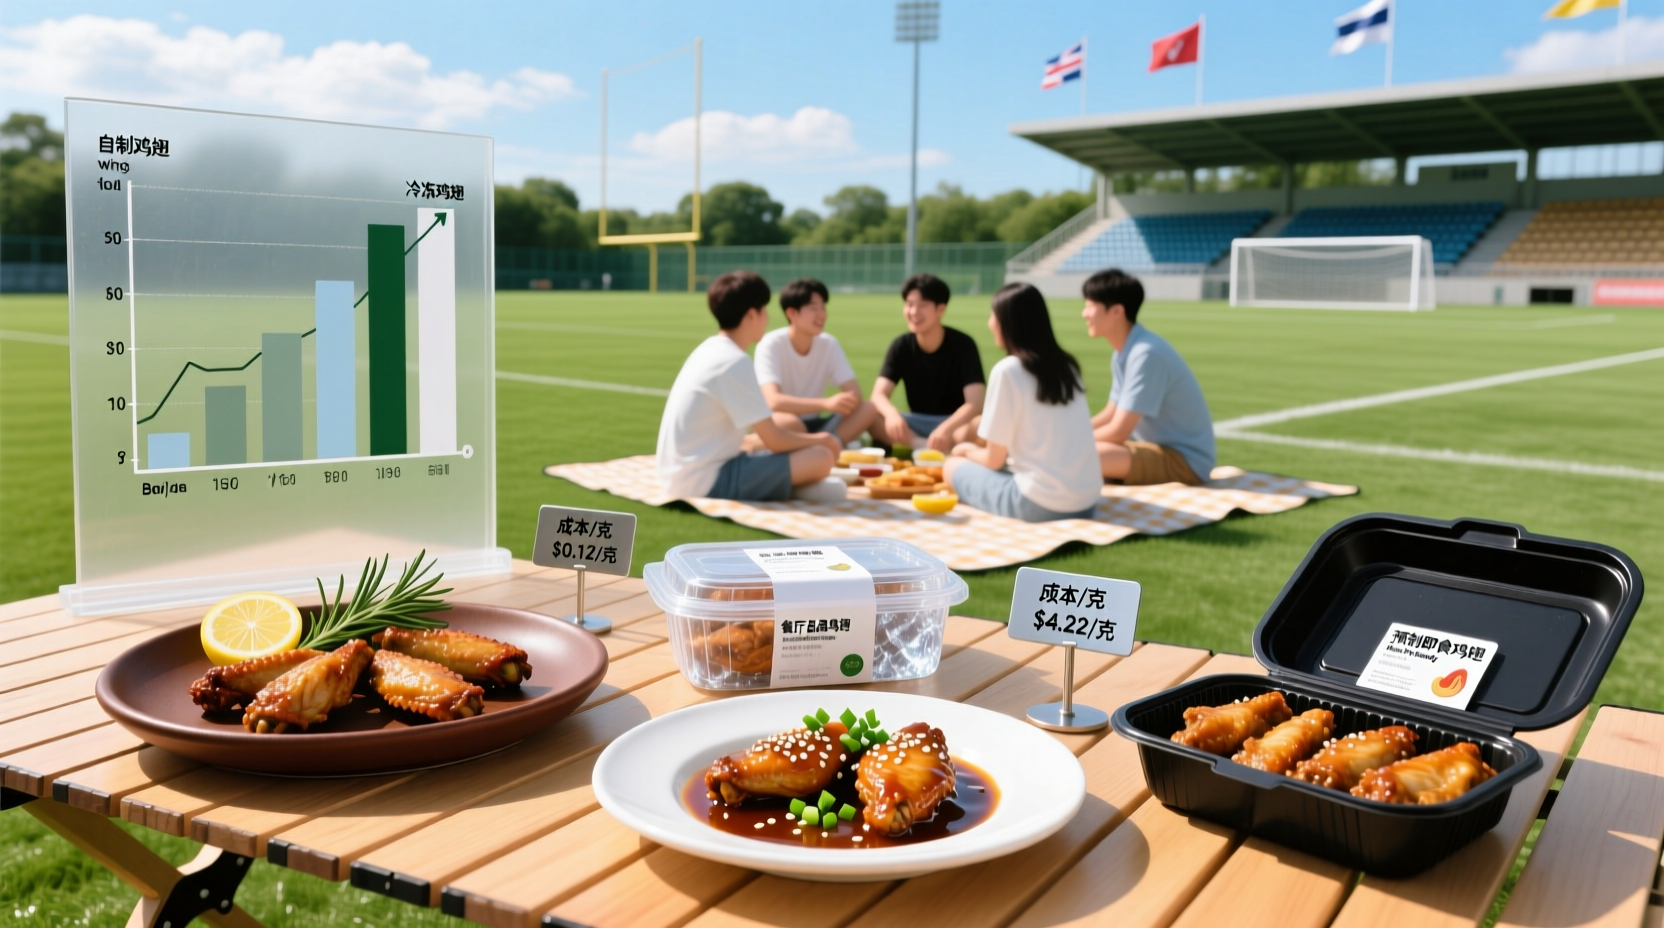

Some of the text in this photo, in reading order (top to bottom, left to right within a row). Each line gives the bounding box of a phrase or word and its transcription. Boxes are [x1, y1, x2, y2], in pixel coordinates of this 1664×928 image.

[99, 134, 170, 157] 自制鸡翅
[107, 396, 126, 411] 10
[556, 515, 613, 539] 成本/克
[552, 541, 617, 564] $0.12/克
[1033, 609, 1117, 642] $4.22/克
